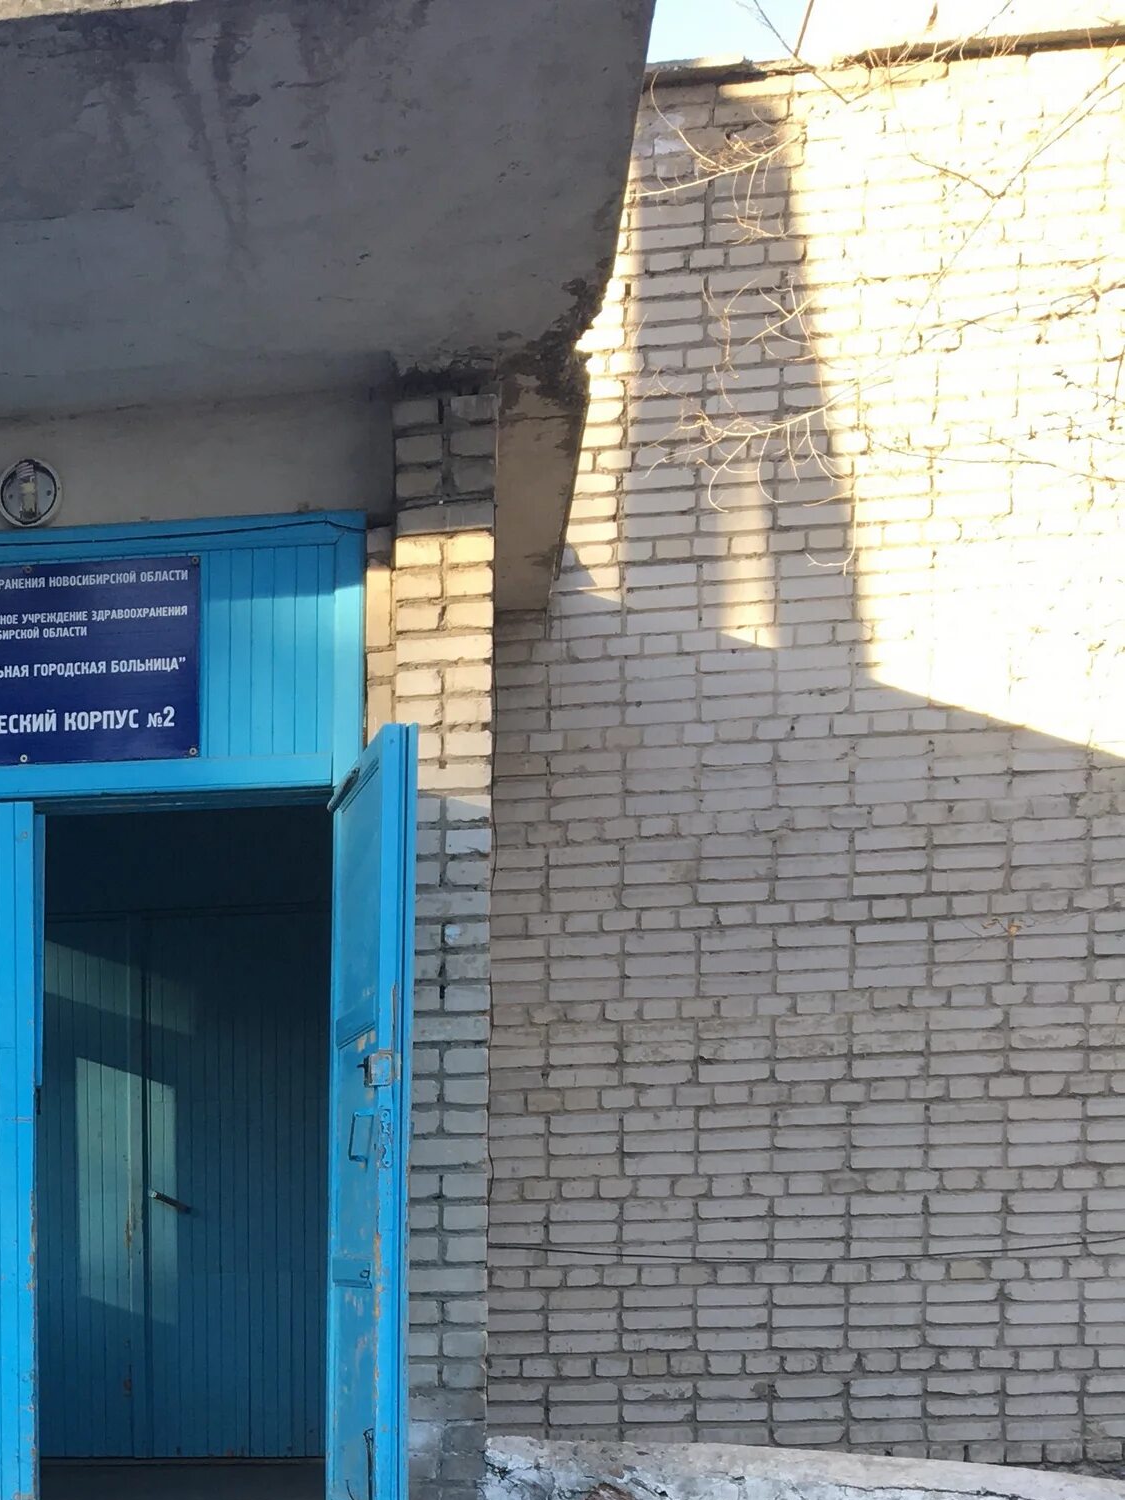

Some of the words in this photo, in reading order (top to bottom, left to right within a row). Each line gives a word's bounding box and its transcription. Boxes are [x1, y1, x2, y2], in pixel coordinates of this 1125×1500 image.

[49, 570, 136, 588] НОВОСИБИРСКОЙ
[140, 569, 188, 582] ОБЛАСТИ
[22, 610, 88, 624] УЧРЕЖДЕНИЕ
[92, 605, 188, 622] ЗДРАВООХРАНЕНИЯ
[43, 626, 87, 638] ОБЛАСТИ
[33, 661, 106, 678] ГОРОДСКАЯ
[64, 709, 139, 731] КОРПУС
